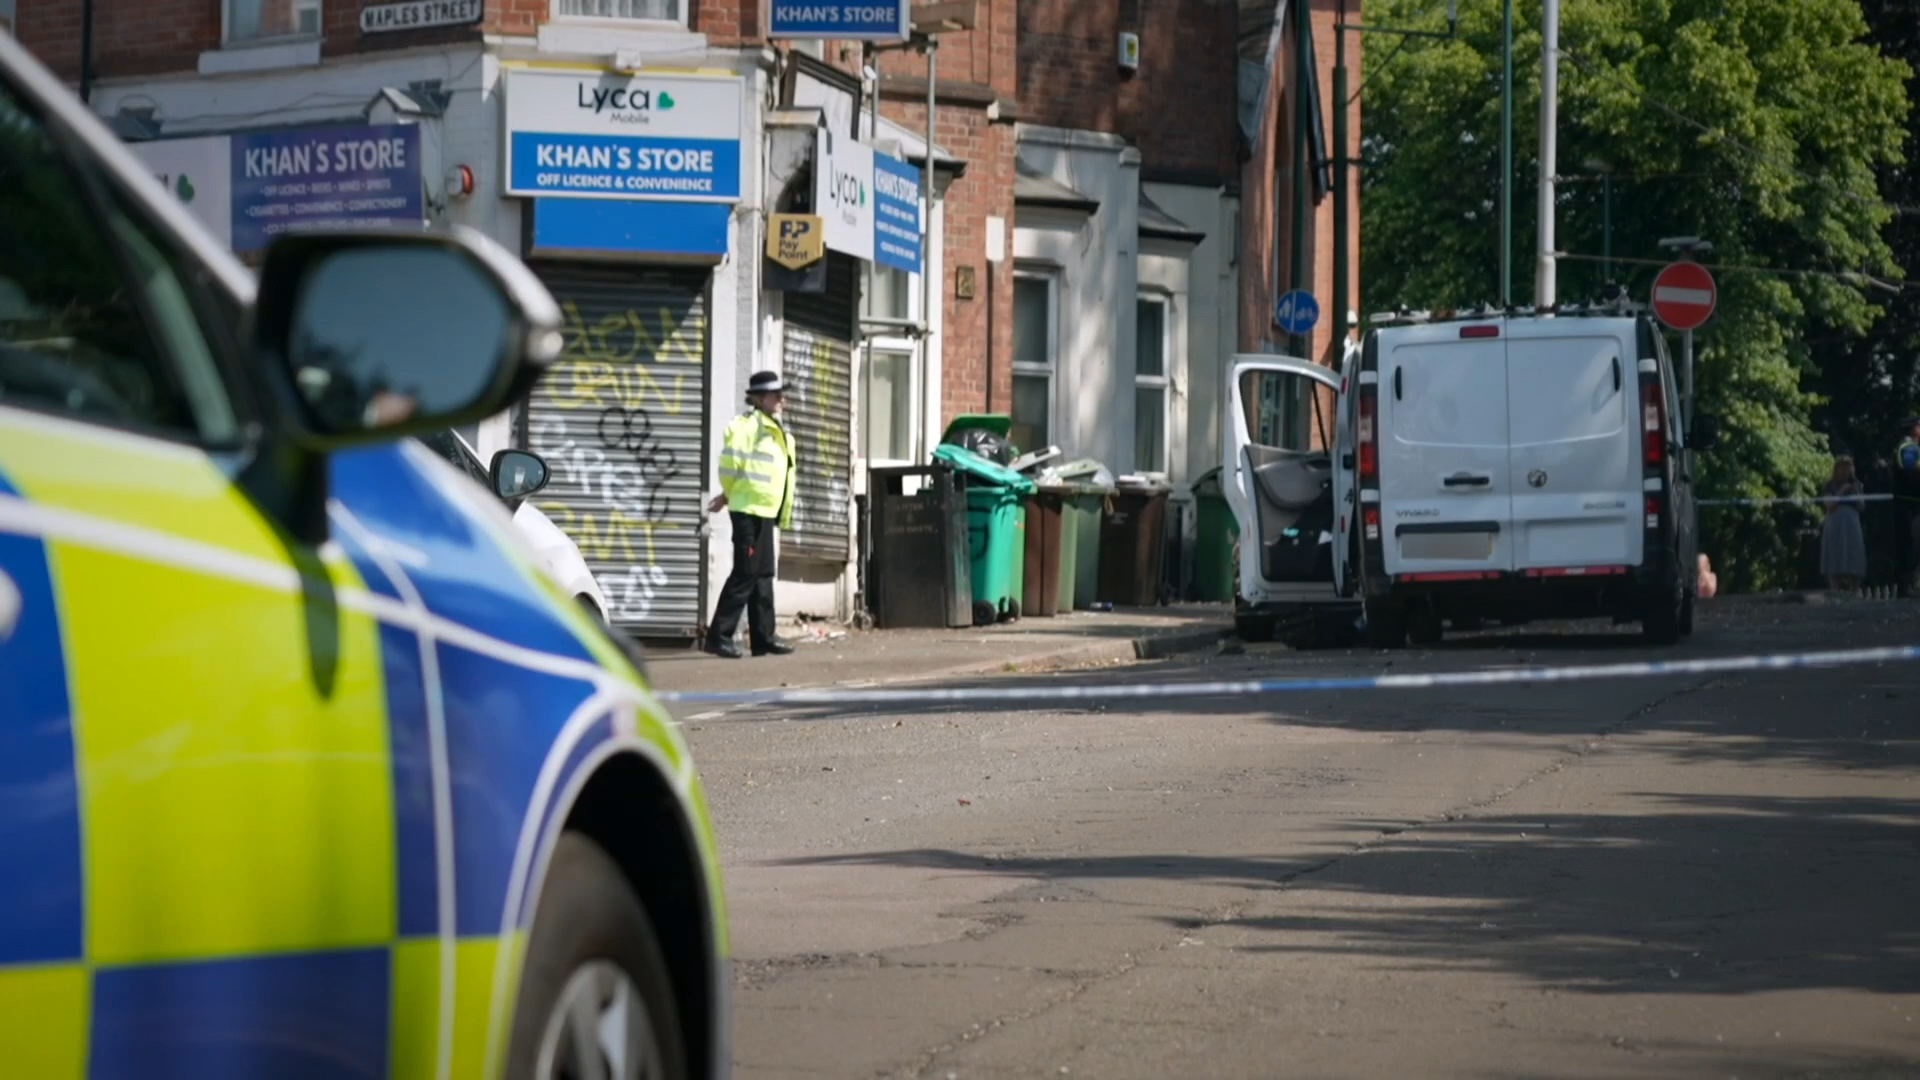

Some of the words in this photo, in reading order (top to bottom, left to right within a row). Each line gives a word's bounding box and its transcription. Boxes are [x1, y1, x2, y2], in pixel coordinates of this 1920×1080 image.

[365, 6, 419, 27] MAPLES
[424, 0, 478, 22] STREET
[776, 5, 839, 22] KHAN'S
[844, 6, 895, 22] STORE
[578, 82, 650, 114] Lyca
[610, 112, 650, 124] Mobile
[245, 140, 330, 177] KHAN'S
[334, 138, 406, 172] STORE
[537, 143, 632, 170] KHAN'S
[638, 147, 714, 173] STORE
[537, 172, 560, 186] OFF
[563, 174, 612, 188] LICENCE
[614, 176, 624, 188] &
[626, 177, 713, 191] CONVENIENCE
[830, 159, 857, 208] Lyca
[779, 241, 799, 251] Pay
[779, 251, 808, 260] Point
